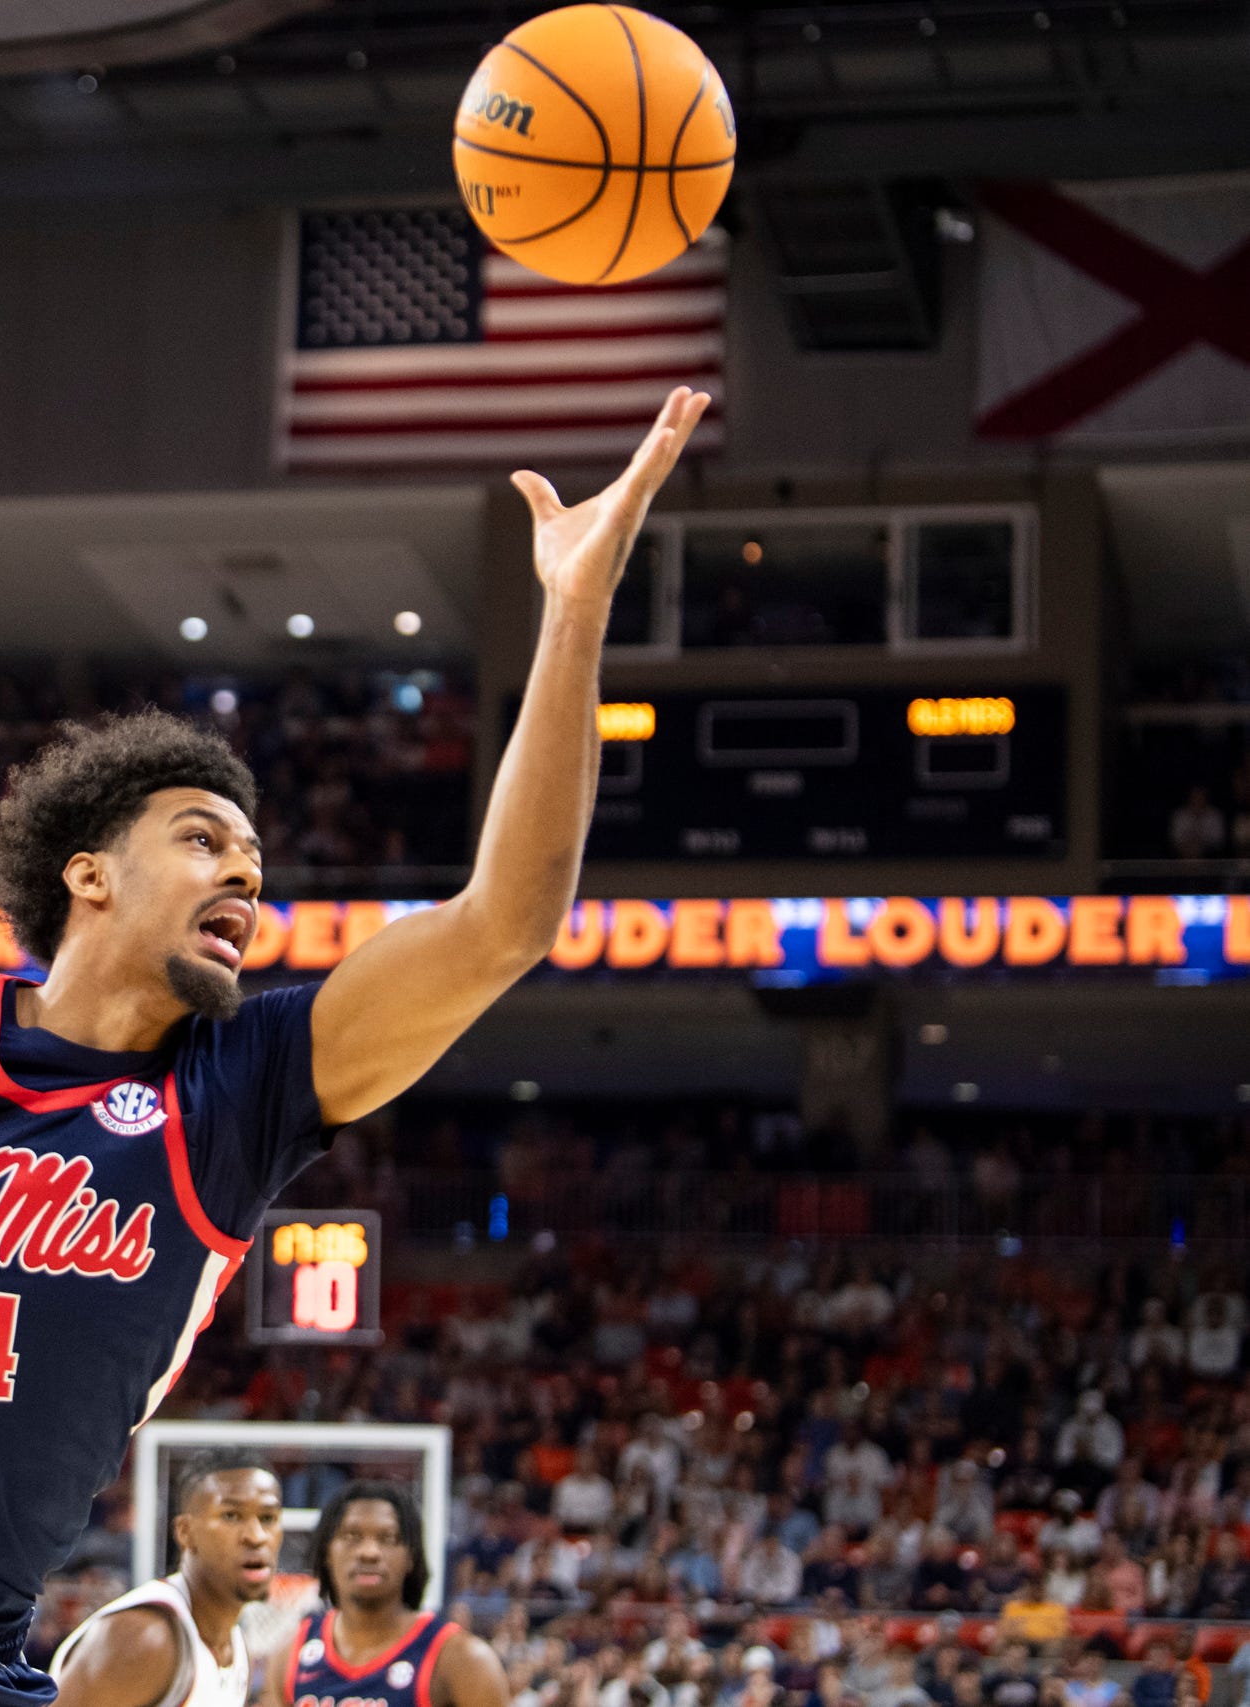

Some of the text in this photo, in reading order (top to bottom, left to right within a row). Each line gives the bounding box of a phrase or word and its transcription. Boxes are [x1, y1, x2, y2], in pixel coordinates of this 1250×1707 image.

[549, 898, 787, 969] UDER
[817, 896, 1188, 968] LOUDER
[107, 1082, 158, 1122] SEC
